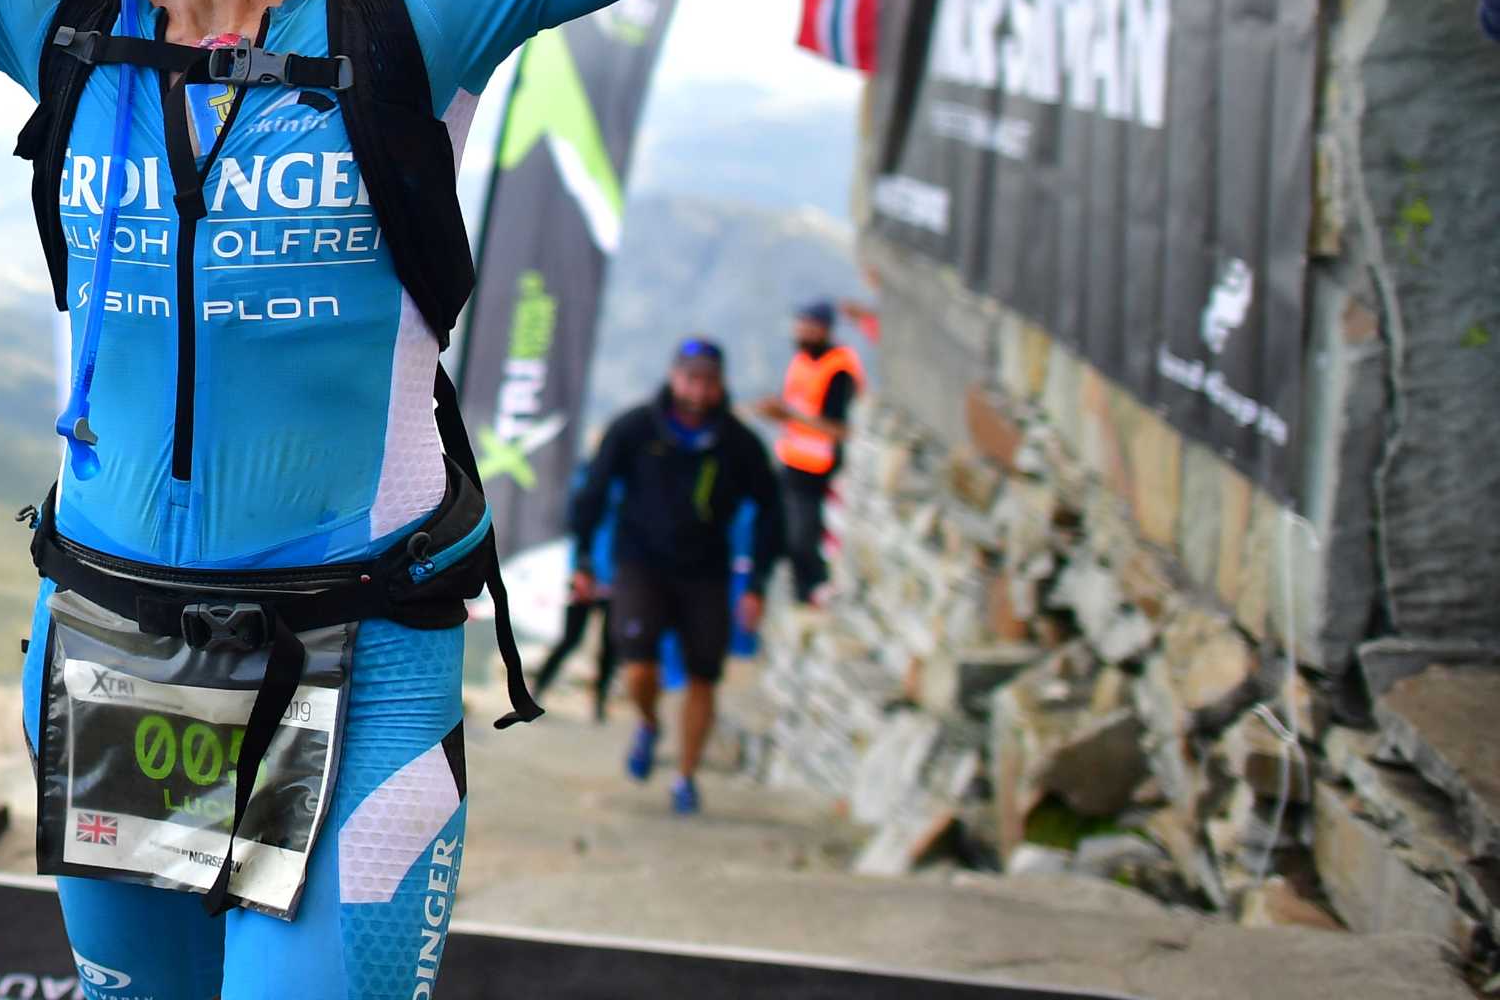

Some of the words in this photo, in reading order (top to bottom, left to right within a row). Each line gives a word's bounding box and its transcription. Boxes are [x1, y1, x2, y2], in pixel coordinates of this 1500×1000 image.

[88, 667, 136, 698] XTRI
[282, 700, 312, 722] 019
[189, 848, 243, 873] NORSEAN
